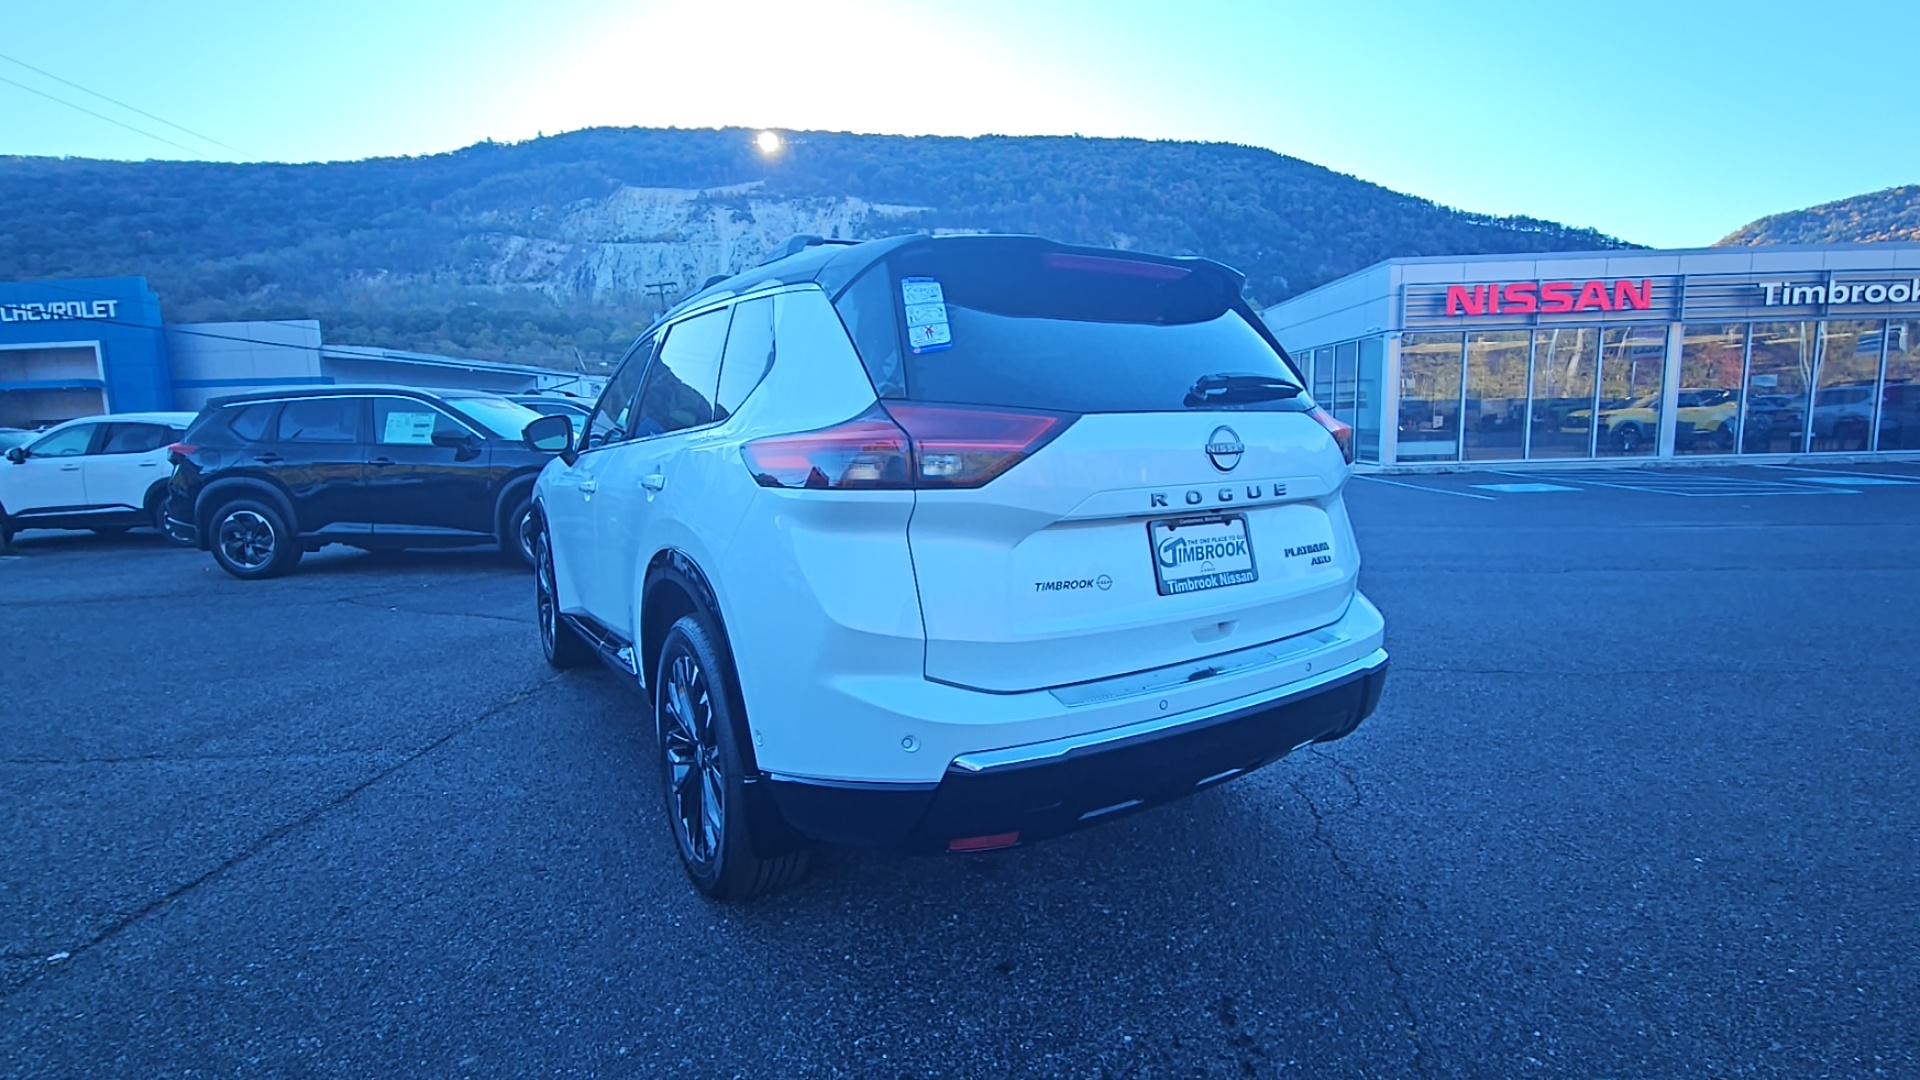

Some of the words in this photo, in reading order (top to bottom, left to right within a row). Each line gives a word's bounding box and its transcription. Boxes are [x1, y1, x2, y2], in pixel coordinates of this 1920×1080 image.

[1446, 279, 1652, 316] NISSAN
[0, 300, 118, 322] CHEVROLET
[1206, 443, 1244, 453] NISSAN
[1150, 483, 1287, 508] ROGUE
[1160, 537, 1247, 567] TIMBROOK
[1035, 579, 1094, 592] TIMBROOK
[1167, 575, 1219, 594] Timbrook
[1219, 572, 1254, 586] Nissan
